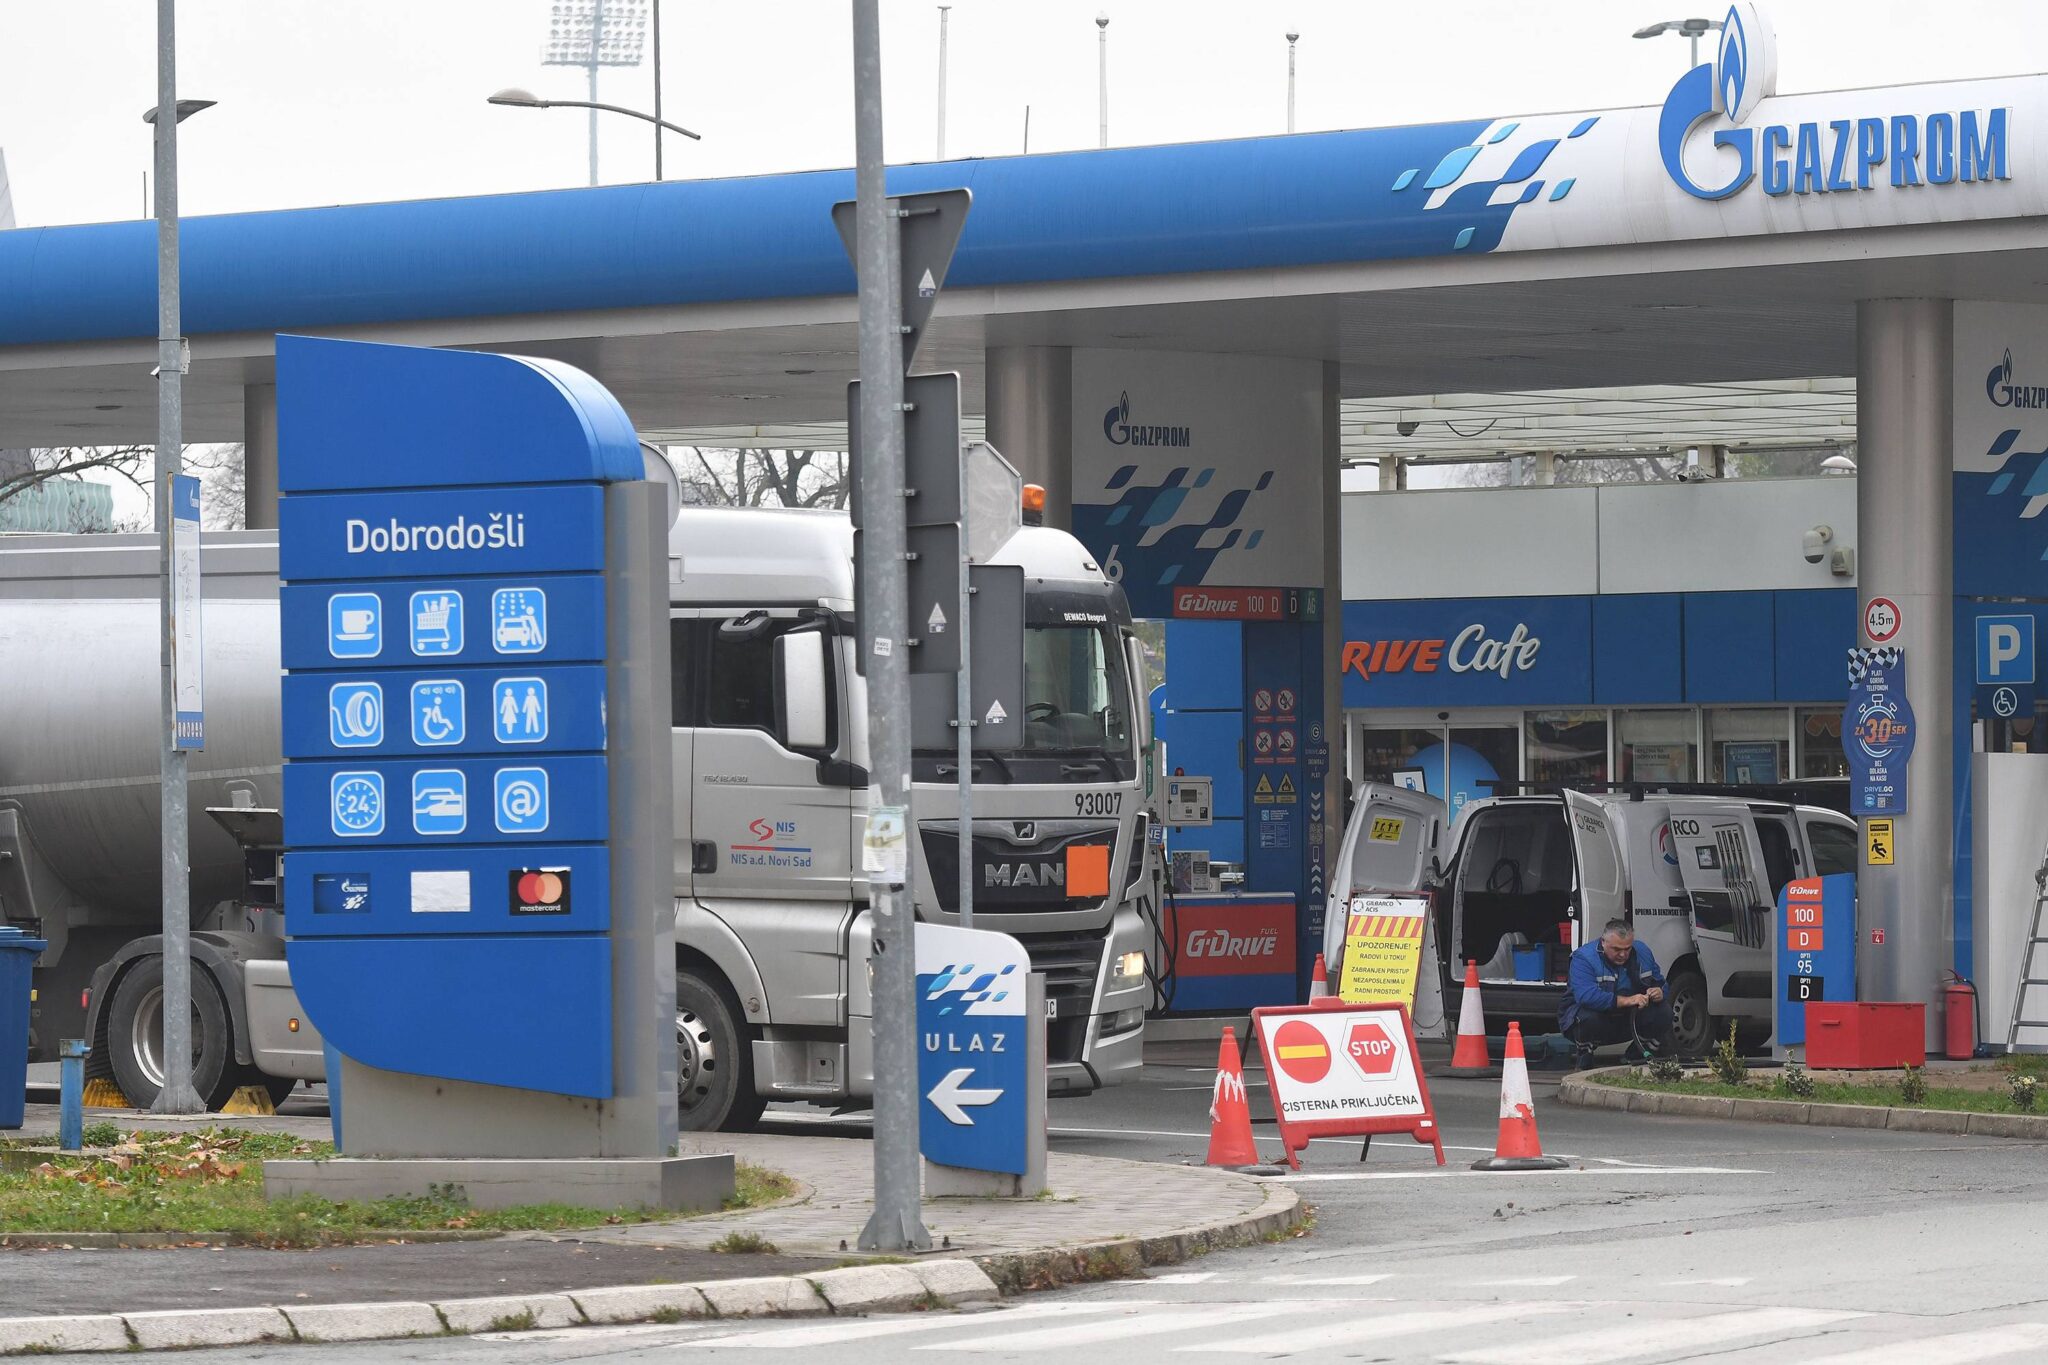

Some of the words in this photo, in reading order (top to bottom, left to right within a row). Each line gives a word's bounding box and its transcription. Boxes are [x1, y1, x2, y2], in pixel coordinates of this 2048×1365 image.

[1762, 107, 2012, 196] GAZPROM
[2014, 385, 2048, 409] GAZP
[1131, 426, 1190, 447] GAZPROM
[347, 513, 525, 553] Dobrodošli
[1247, 596, 1264, 613] 100
[1272, 596, 1279, 613] D
[1448, 623, 1541, 680] Cafe
[1989, 624, 2021, 676] P
[1854, 726, 1864, 735] ZA
[1864, 718, 1891, 743] 30
[1891, 725, 1907, 735] SEK
[347, 795, 370, 815] 24
[1075, 792, 1122, 816] 93007
[776, 822, 795, 832] NIS
[731, 854, 747, 865] NIS
[750, 855, 766, 865] a.d.
[769, 855, 790, 867] Novi
[793, 856, 811, 867] Sad
[985, 863, 1064, 887] MAN
[520, 904, 561, 912] mastercard
[1795, 908, 1814, 922] 100
[1357, 942, 1411, 950] UPOZORENJE!
[1800, 932, 1809, 946] D
[1351, 966, 1386, 974] ZABRANJEN
[1797, 960, 1812, 973] 95
[1800, 985, 1810, 999] D
[925, 1033, 1006, 1052] ULAZ
[1351, 1039, 1391, 1057] STOP
[1282, 1098, 1339, 1113] CISTERNA
[1340, 1093, 1419, 1110] PRIKLJUČENA
